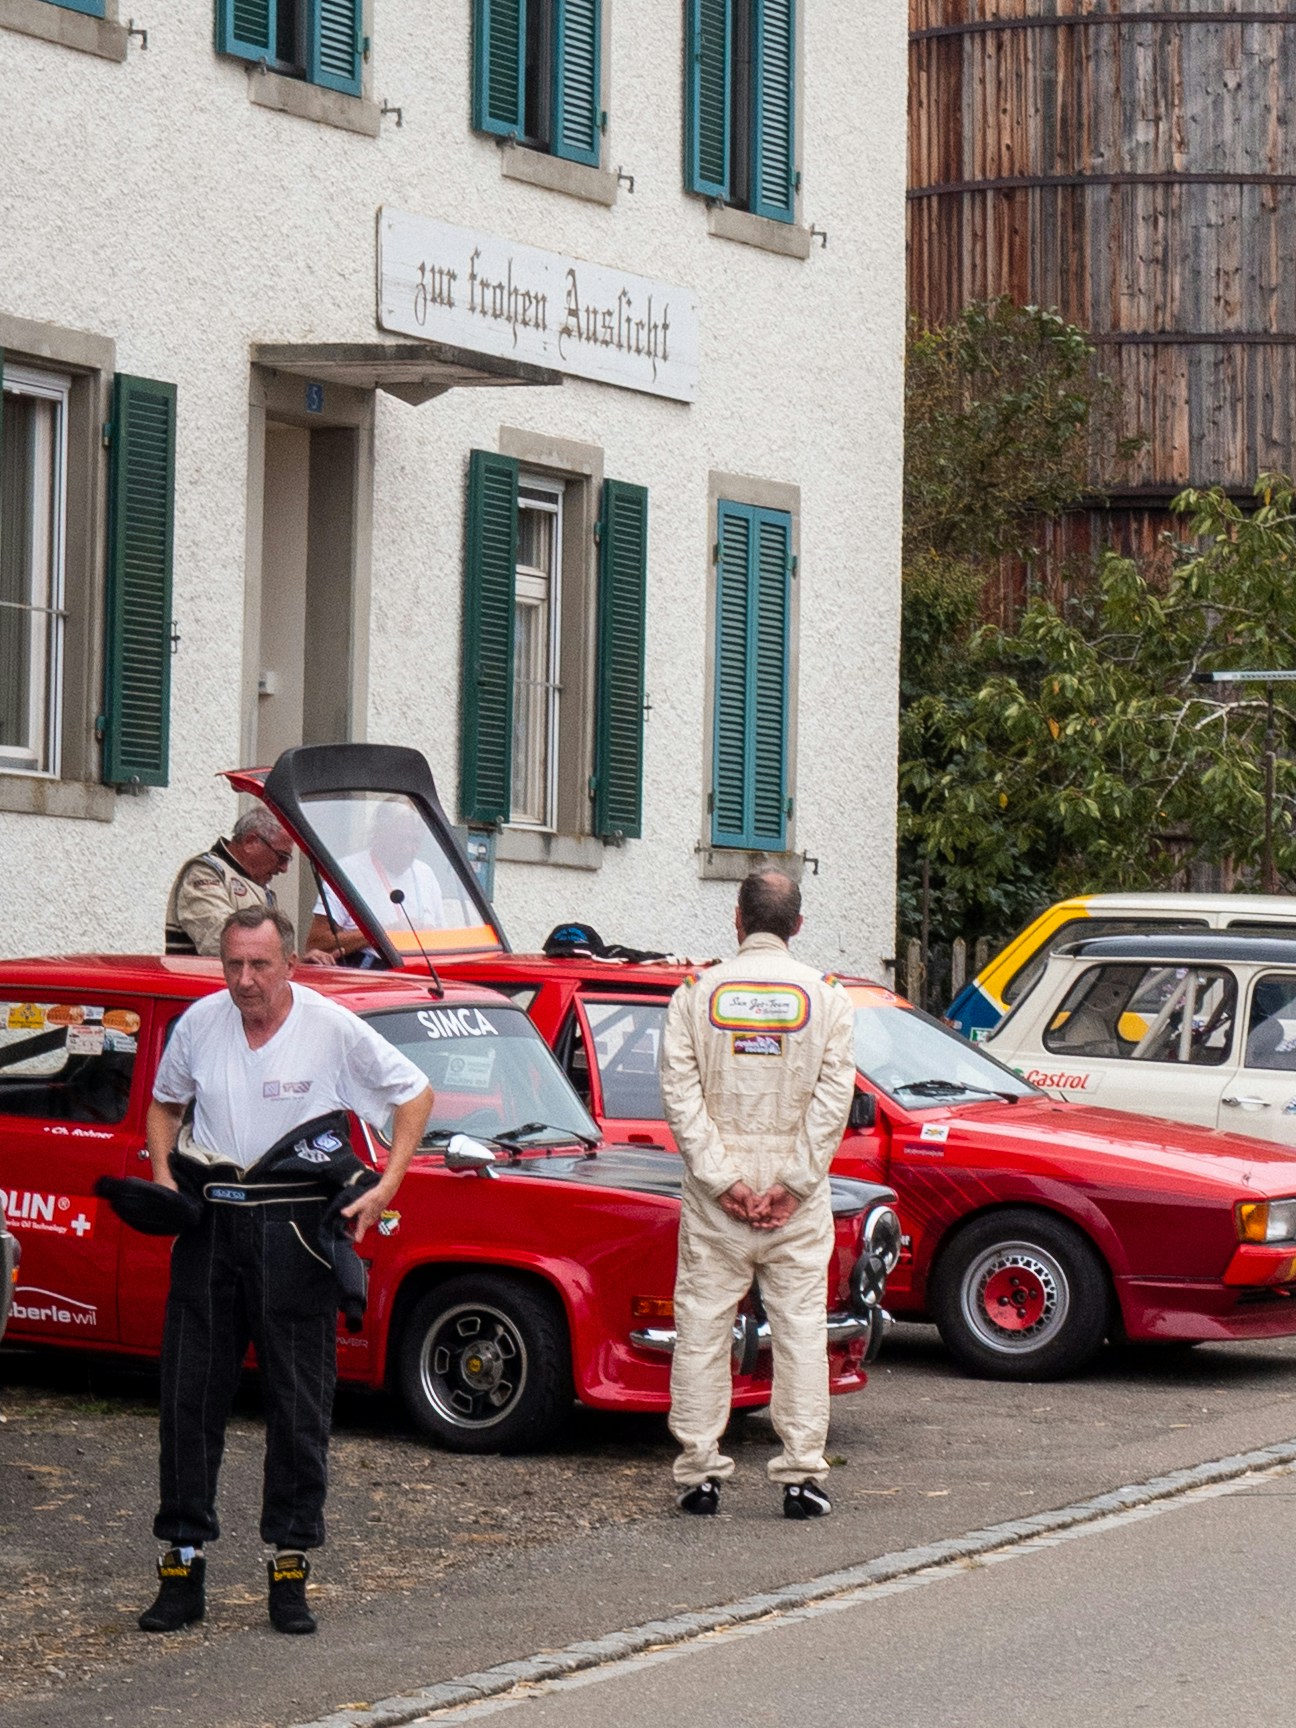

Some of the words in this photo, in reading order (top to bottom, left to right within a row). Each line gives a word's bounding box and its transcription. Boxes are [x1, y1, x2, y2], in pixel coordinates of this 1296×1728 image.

[414, 260, 457, 326] zur
[467, 246, 548, 349] frohen
[416, 1008, 499, 1040] SIMCA
[1026, 1069, 1091, 1090] Castrol
